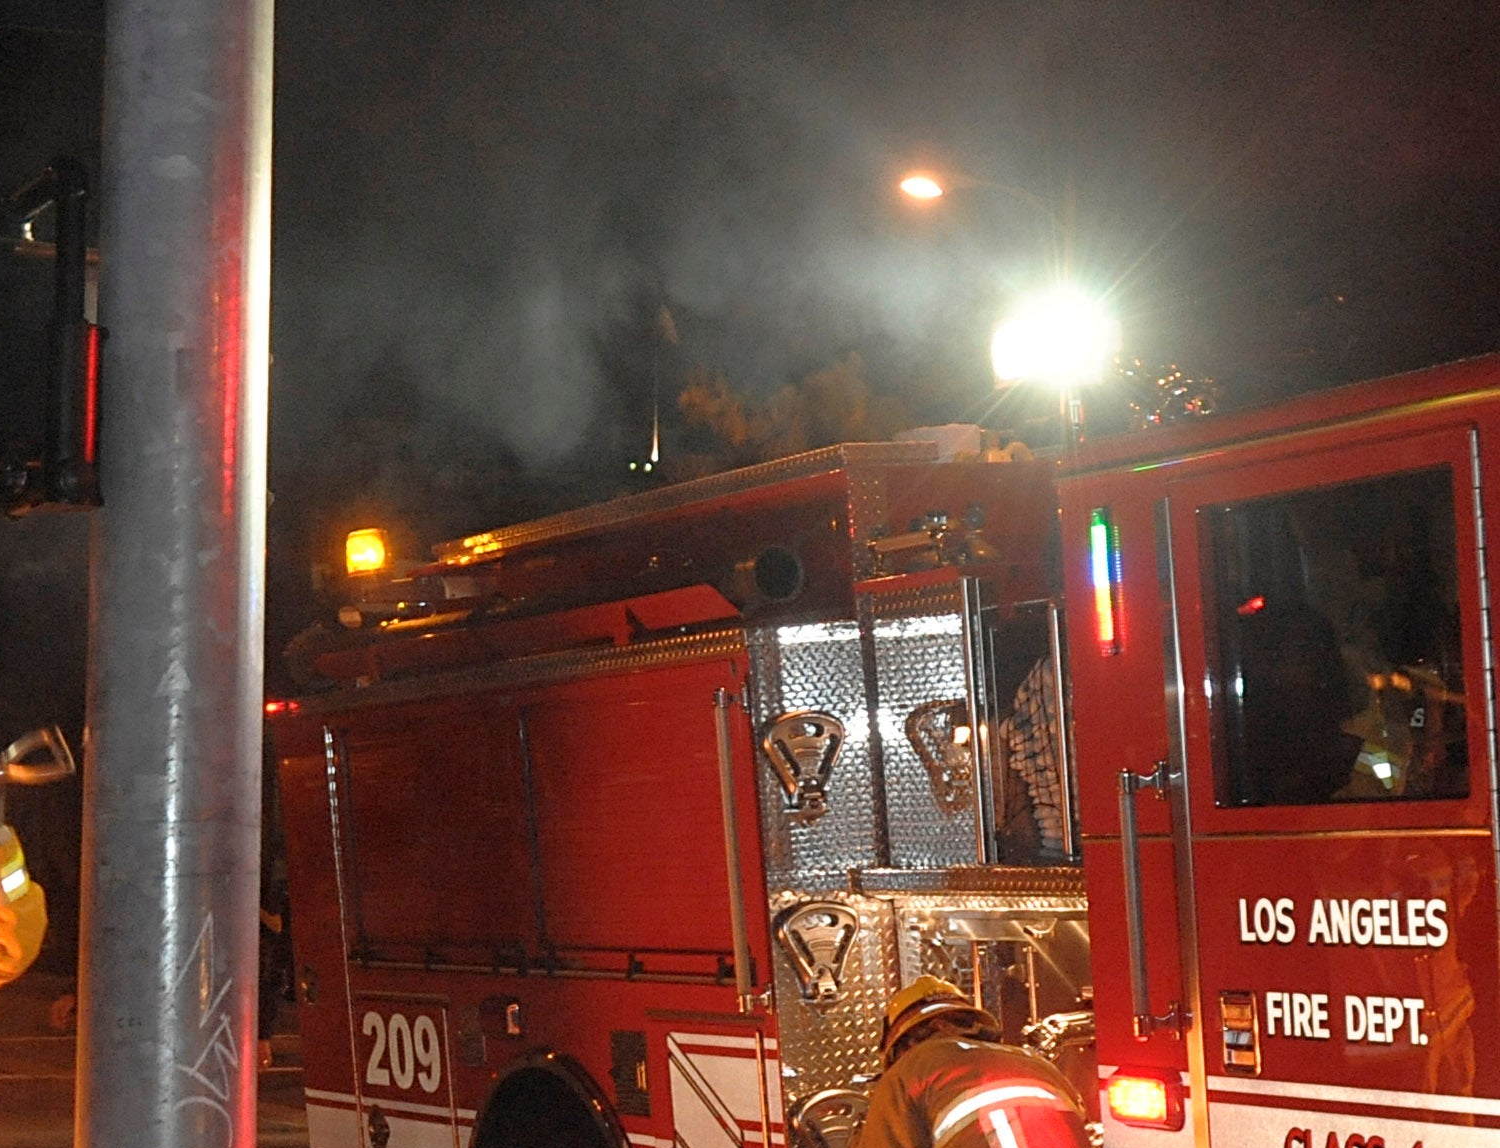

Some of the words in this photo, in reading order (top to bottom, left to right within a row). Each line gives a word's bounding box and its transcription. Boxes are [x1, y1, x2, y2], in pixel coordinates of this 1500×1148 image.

[1239, 898, 1296, 944] LOS
[1309, 898, 1449, 947] ANGELES
[1266, 991, 1330, 1039] FIRE
[1345, 995, 1429, 1045] DEPT.
[363, 1012, 441, 1093] 209
